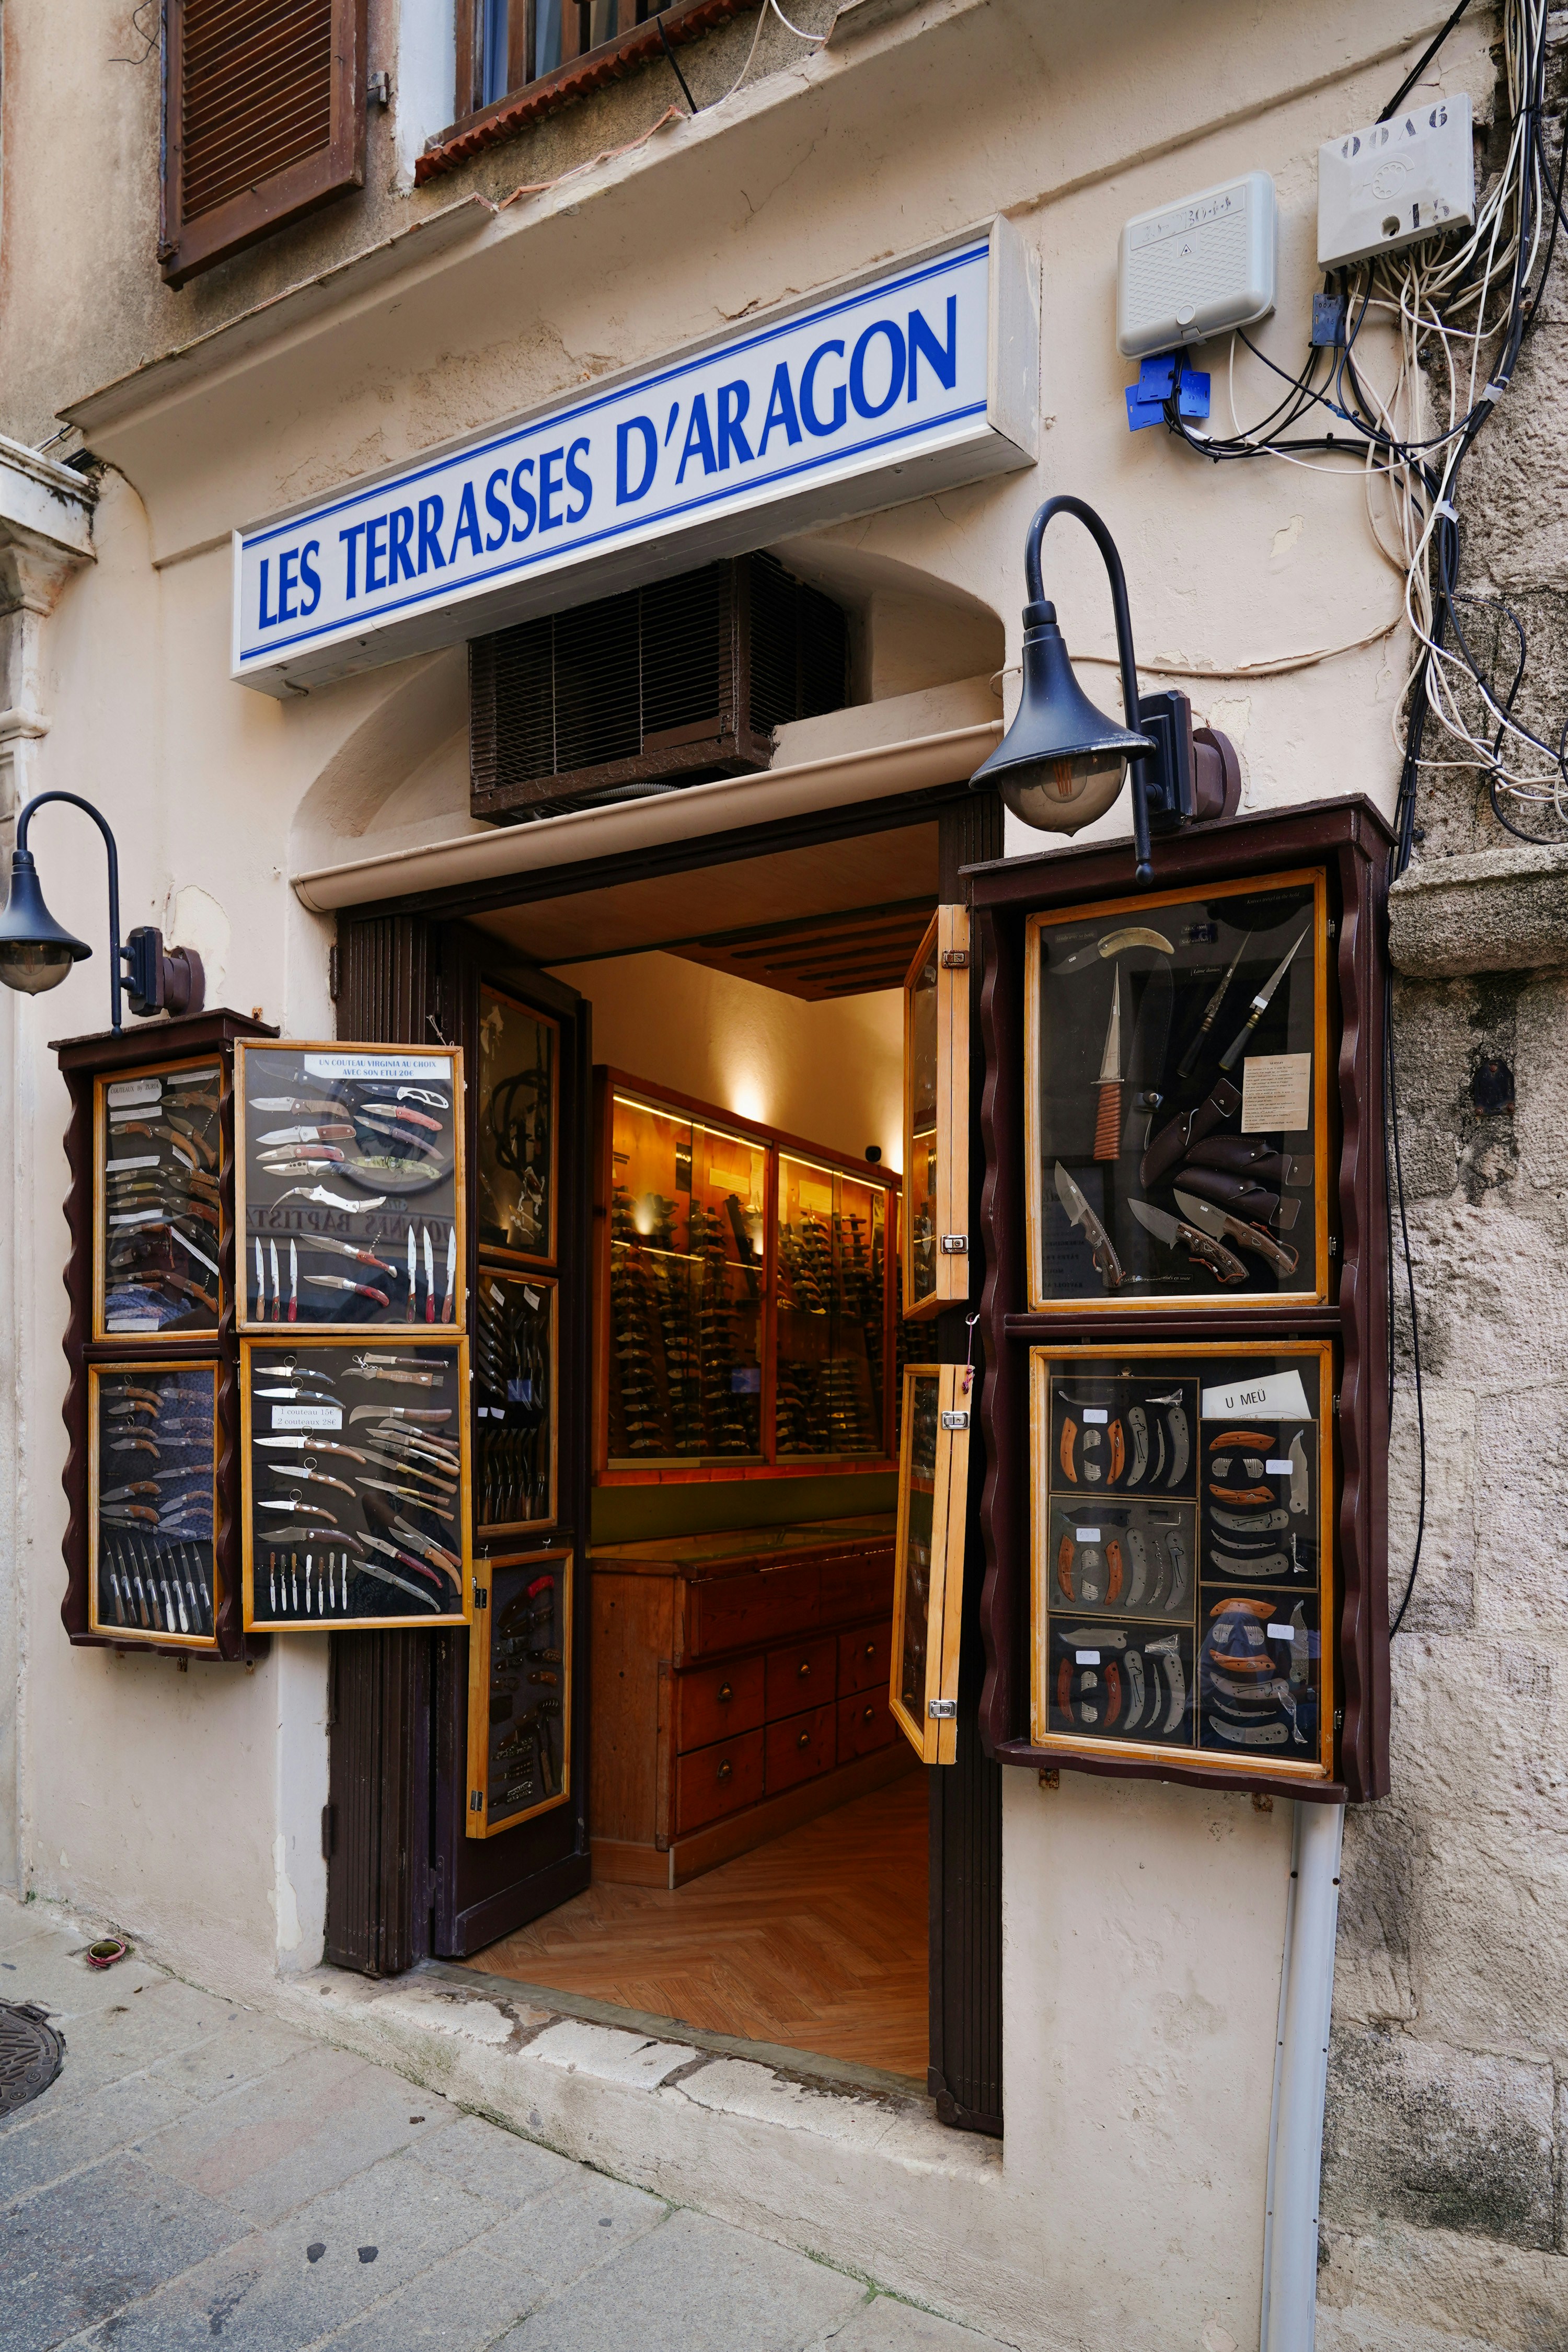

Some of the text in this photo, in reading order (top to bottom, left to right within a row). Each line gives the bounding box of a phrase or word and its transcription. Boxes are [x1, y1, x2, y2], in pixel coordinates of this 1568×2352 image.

[1341, 105, 1448, 158] 00A6
[259, 294, 958, 630] LES TERRASSES D'ARAGON
[1225, 1389, 1266, 1409] U MEÜ
